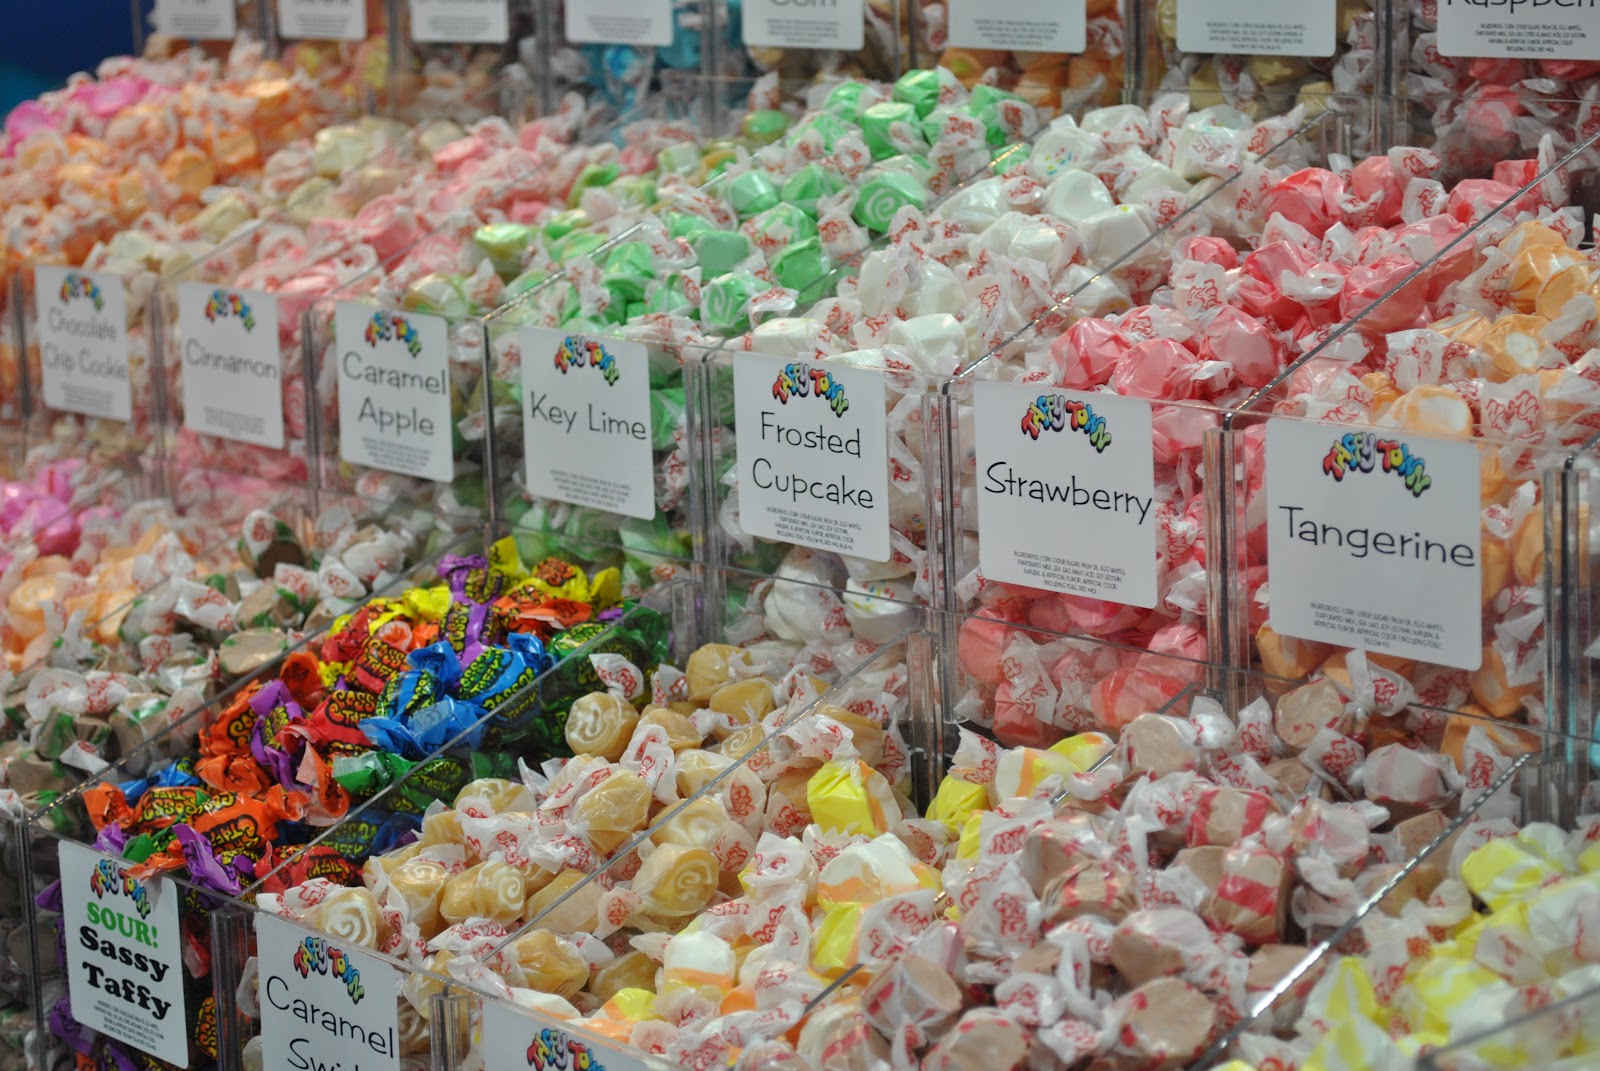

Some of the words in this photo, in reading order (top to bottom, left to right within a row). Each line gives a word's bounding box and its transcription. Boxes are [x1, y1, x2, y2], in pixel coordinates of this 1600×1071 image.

[185, 337, 277, 379] Cinnamon
[343, 351, 446, 395] Caramel
[358, 396, 435, 436] Apple
[530, 391, 577, 434] Key
[588, 403, 647, 440] Lime
[761, 411, 861, 458] Frosted
[1021, 394, 1065, 440] TAFFY
[1066, 400, 1111, 453] TOWN
[752, 458, 874, 509] Cupcake
[1323, 432, 1376, 482] TAFFY
[1376, 438, 1432, 498] TOWN
[985, 462, 1152, 525] Strawberry
[1279, 506, 1475, 567] Tangerine
[87, 901, 159, 949] SOUR!
[79, 925, 170, 983] Sassy
[293, 936, 328, 979] TAFFY
[328, 946, 365, 1005] TOWN
[82, 961, 172, 1021] Taffy
[266, 975, 394, 1059] Caramel
[527, 1028, 568, 1071] TAFFY
[568, 1040, 607, 1071] TOW
